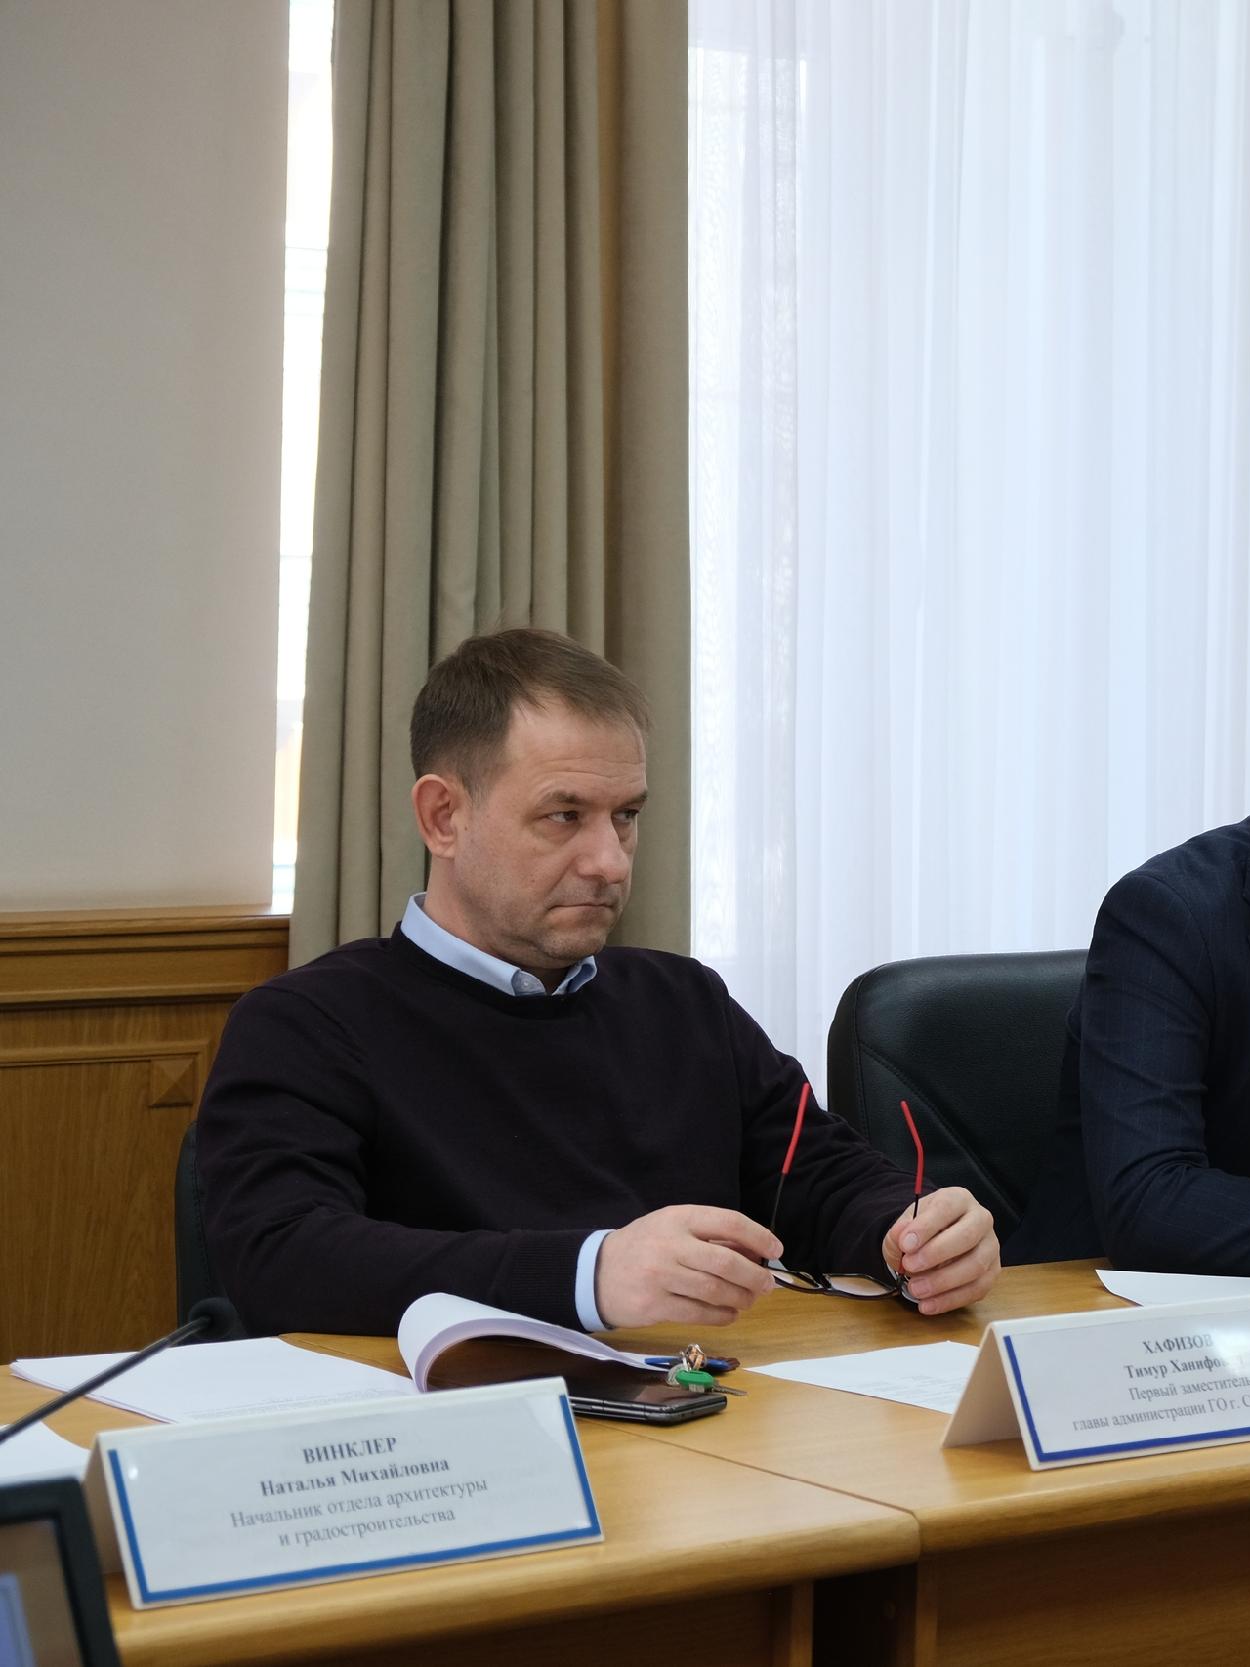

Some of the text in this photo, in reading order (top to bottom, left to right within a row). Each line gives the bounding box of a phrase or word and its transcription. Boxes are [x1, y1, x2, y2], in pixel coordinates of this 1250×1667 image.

[1142, 1334, 1214, 1354] ХАФИЗОВ
[1124, 1364, 1168, 1379] Тимур
[1128, 1383, 1178, 1402] Первый
[1072, 1416, 1110, 1431] главы
[1111, 1402, 1207, 1427] администрации
[1207, 1397, 1228, 1413] ГО
[303, 1437, 396, 1464] ВИНКЛЕР
[260, 1459, 450, 1497] Наталья Михайловна
[230, 1479, 488, 1528] Начальник отдела архитектуры
[279, 1509, 456, 1547] и градостроительства
